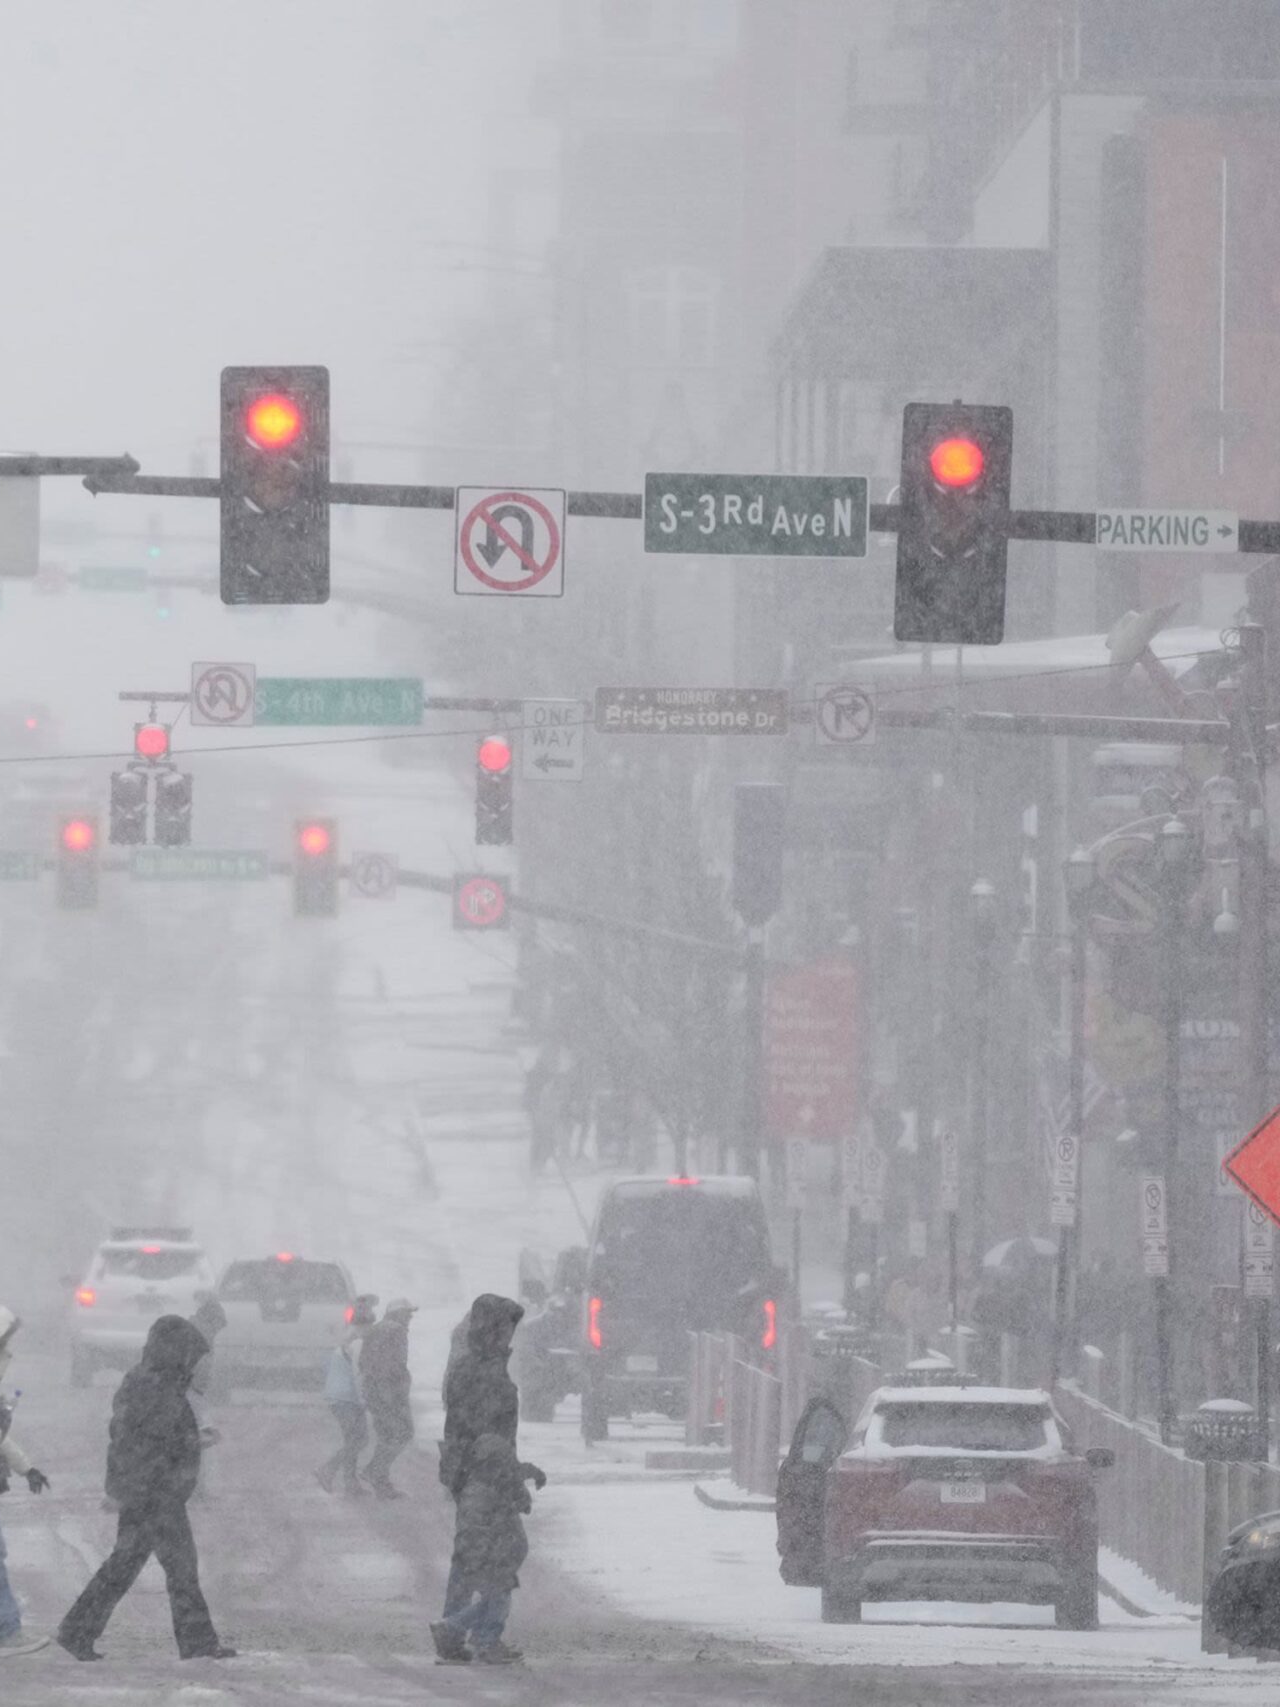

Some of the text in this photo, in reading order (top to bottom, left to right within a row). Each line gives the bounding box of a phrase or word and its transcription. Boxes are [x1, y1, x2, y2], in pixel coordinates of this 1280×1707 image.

[771, 505, 826, 537] Ave
[833, 498, 852, 537] N
[1097, 513, 1209, 546] PARKING
[656, 690, 719, 705] HONORARY
[533, 706, 577, 726] ONE
[605, 703, 777, 731] Bridgestone Dr
[532, 728, 577, 748] WAY
